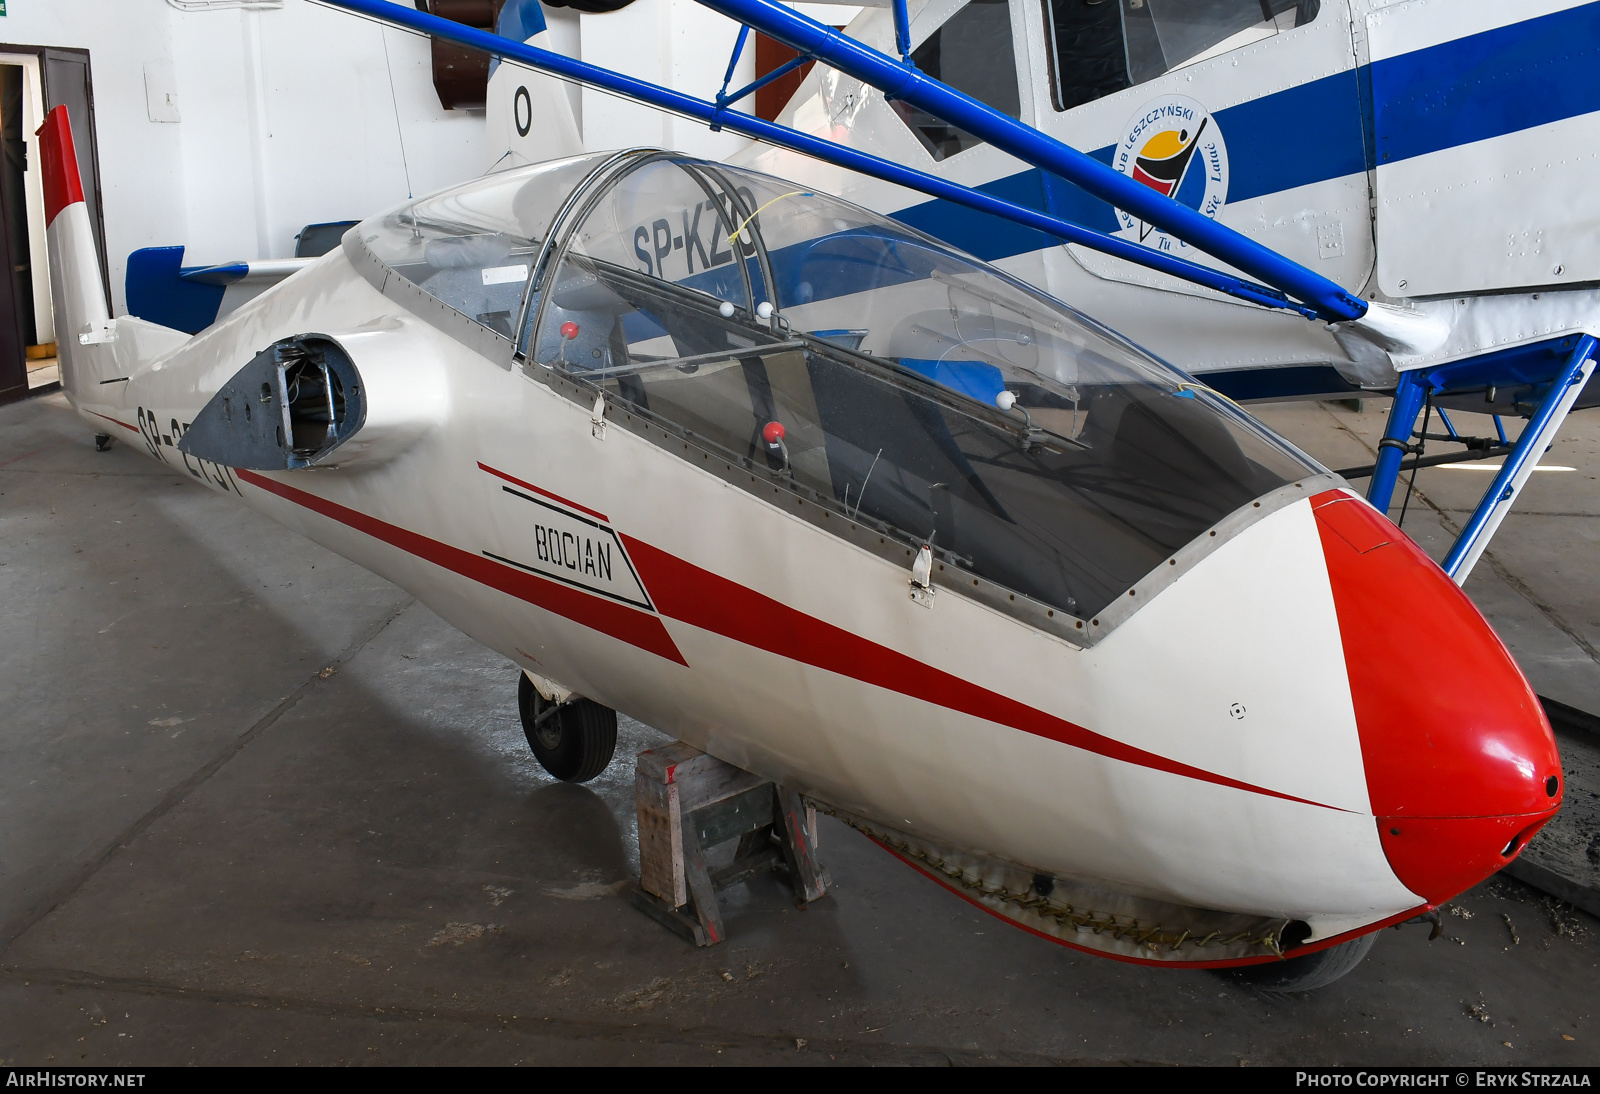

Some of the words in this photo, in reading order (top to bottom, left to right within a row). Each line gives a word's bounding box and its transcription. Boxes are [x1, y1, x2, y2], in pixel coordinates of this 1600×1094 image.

[1125, 103, 1194, 150] LESZCZYŃSKI
[1204, 142, 1222, 183] Latać
[1158, 236, 1171, 250] Tu
[534, 524, 612, 581] BOCIAN
